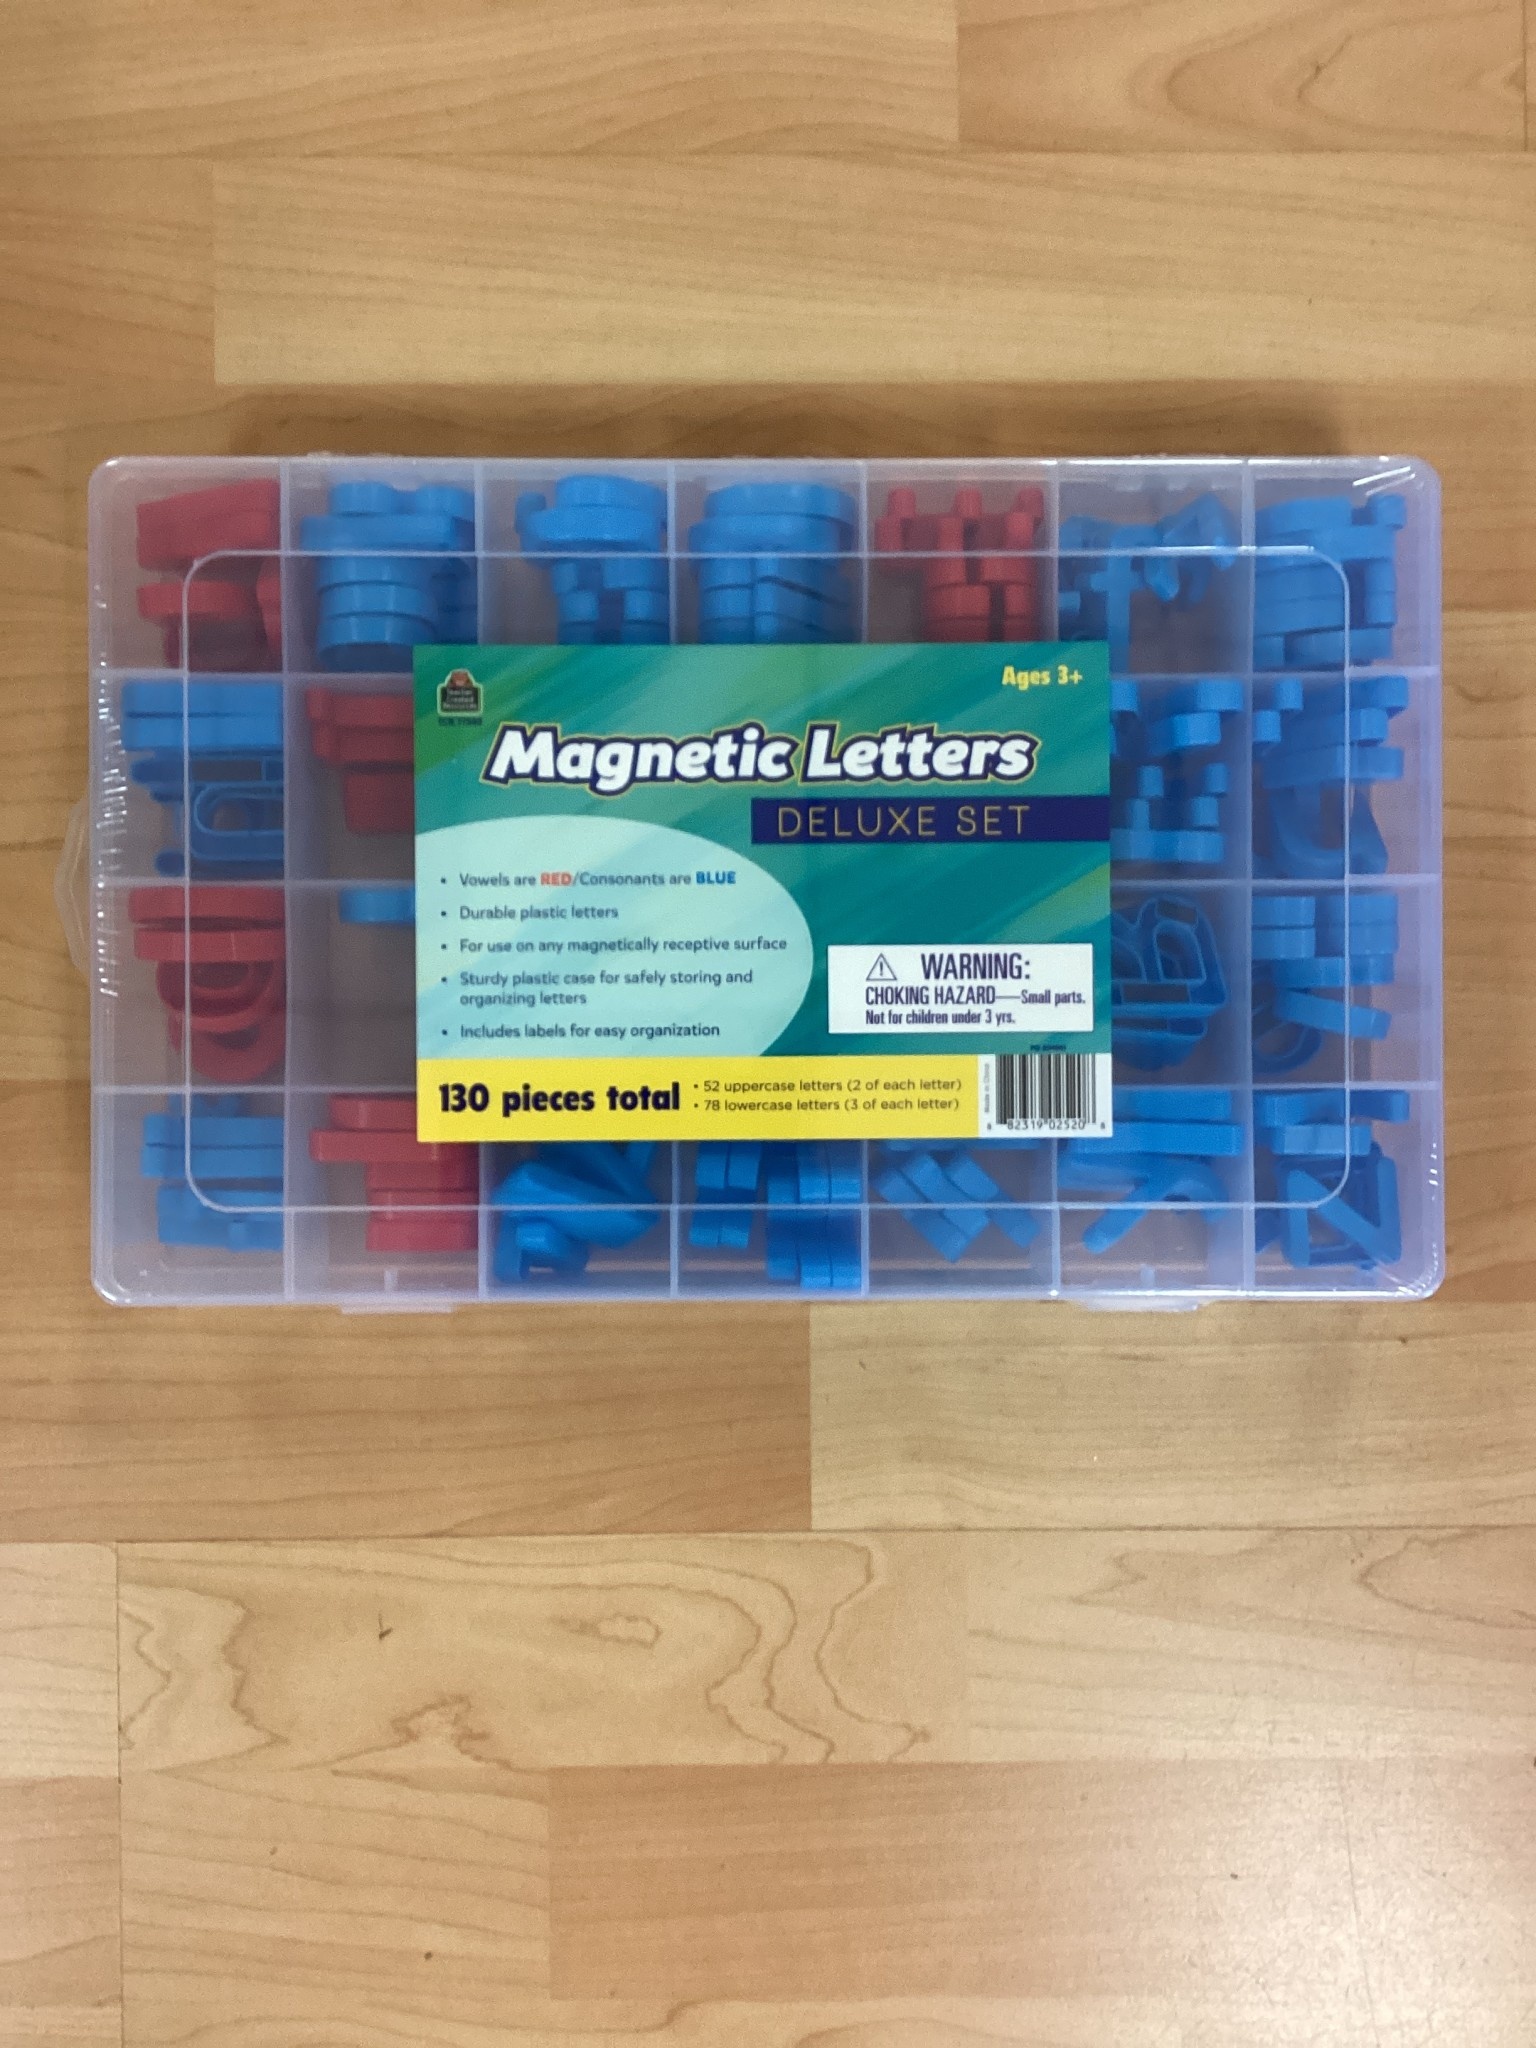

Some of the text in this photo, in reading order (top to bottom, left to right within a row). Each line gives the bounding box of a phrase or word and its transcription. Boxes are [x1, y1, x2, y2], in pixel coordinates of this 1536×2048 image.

[1002, 665, 1083, 691] Ages 3+
[483, 723, 1039, 796] Magnetic Letters
[778, 805, 1030, 837] DELUXE SET
[460, 872, 510, 887] Vowels
[514, 875, 536, 886] are
[669, 874, 692, 885] are
[696, 871, 736, 885] BLUE
[460, 905, 619, 922] Durable plastic letters
[460, 937, 787, 955] For use on any magnetically receptive surface
[921, 952, 1031, 980] WARNING:
[460, 969, 753, 988] Sturdy plastic case for safely storing and
[460, 991, 587, 1008] organizing letters
[865, 986, 930, 1006] CHOKING
[1054, 991, 1086, 1007] parts.
[865, 1009, 1016, 1027] Not for children under 3 yrs.
[460, 1022, 720, 1040] Includes labels for easy organization
[703, 1078, 962, 1093] 52 uppercase letters (2 of each letter)
[439, 1081, 681, 1118] 130 pieces total
[704, 1098, 959, 1111] 78 lowercase letters (3 of each letter)
[1007, 1119, 1043, 1131] 82319
[1048, 1119, 1086, 1131] 02520
